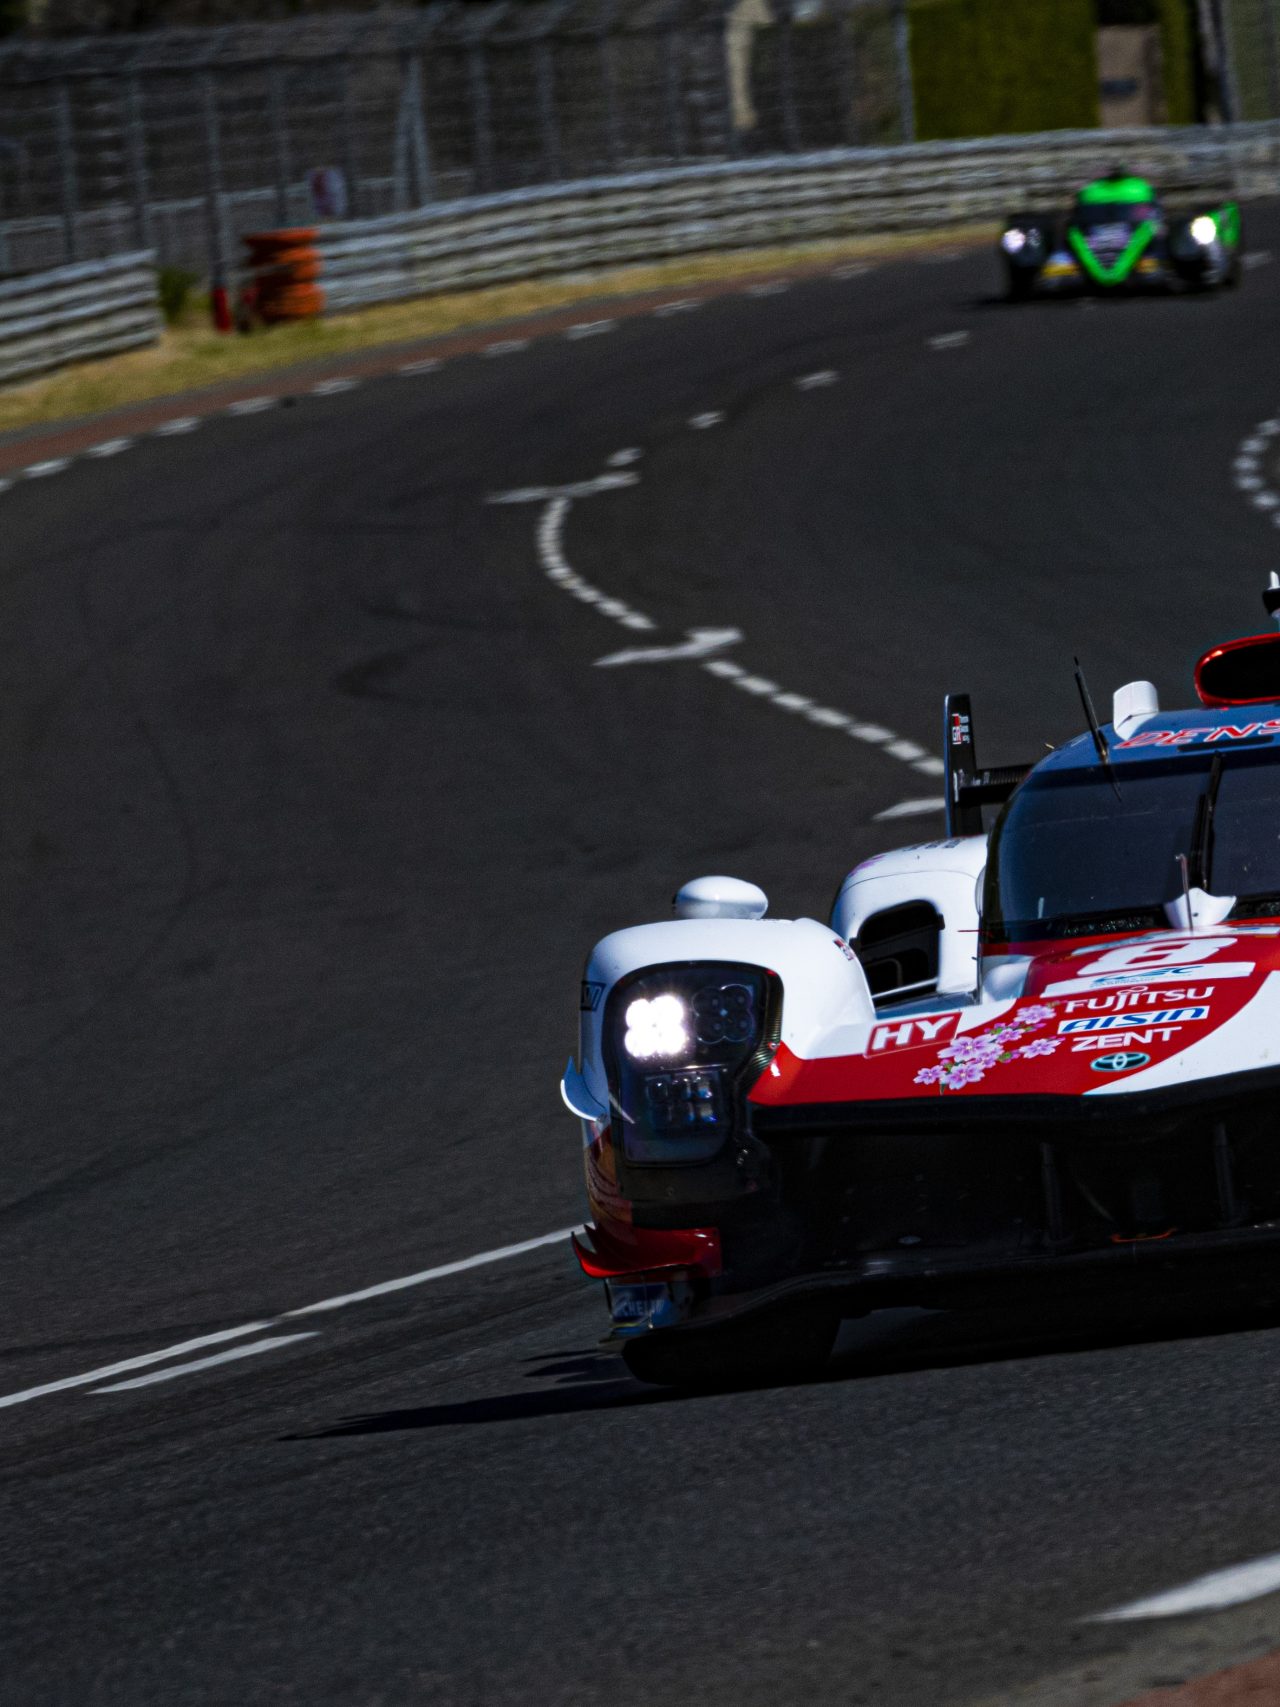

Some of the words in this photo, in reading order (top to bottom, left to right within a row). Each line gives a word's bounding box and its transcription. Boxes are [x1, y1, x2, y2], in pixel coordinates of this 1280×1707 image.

[1077, 937, 1239, 976] 8
[1065, 985, 1215, 1013] FUJITSU
[872, 1016, 955, 1051] HY
[1061, 1007, 1206, 1033] AISIN
[1071, 1026, 1183, 1052] ZENT
